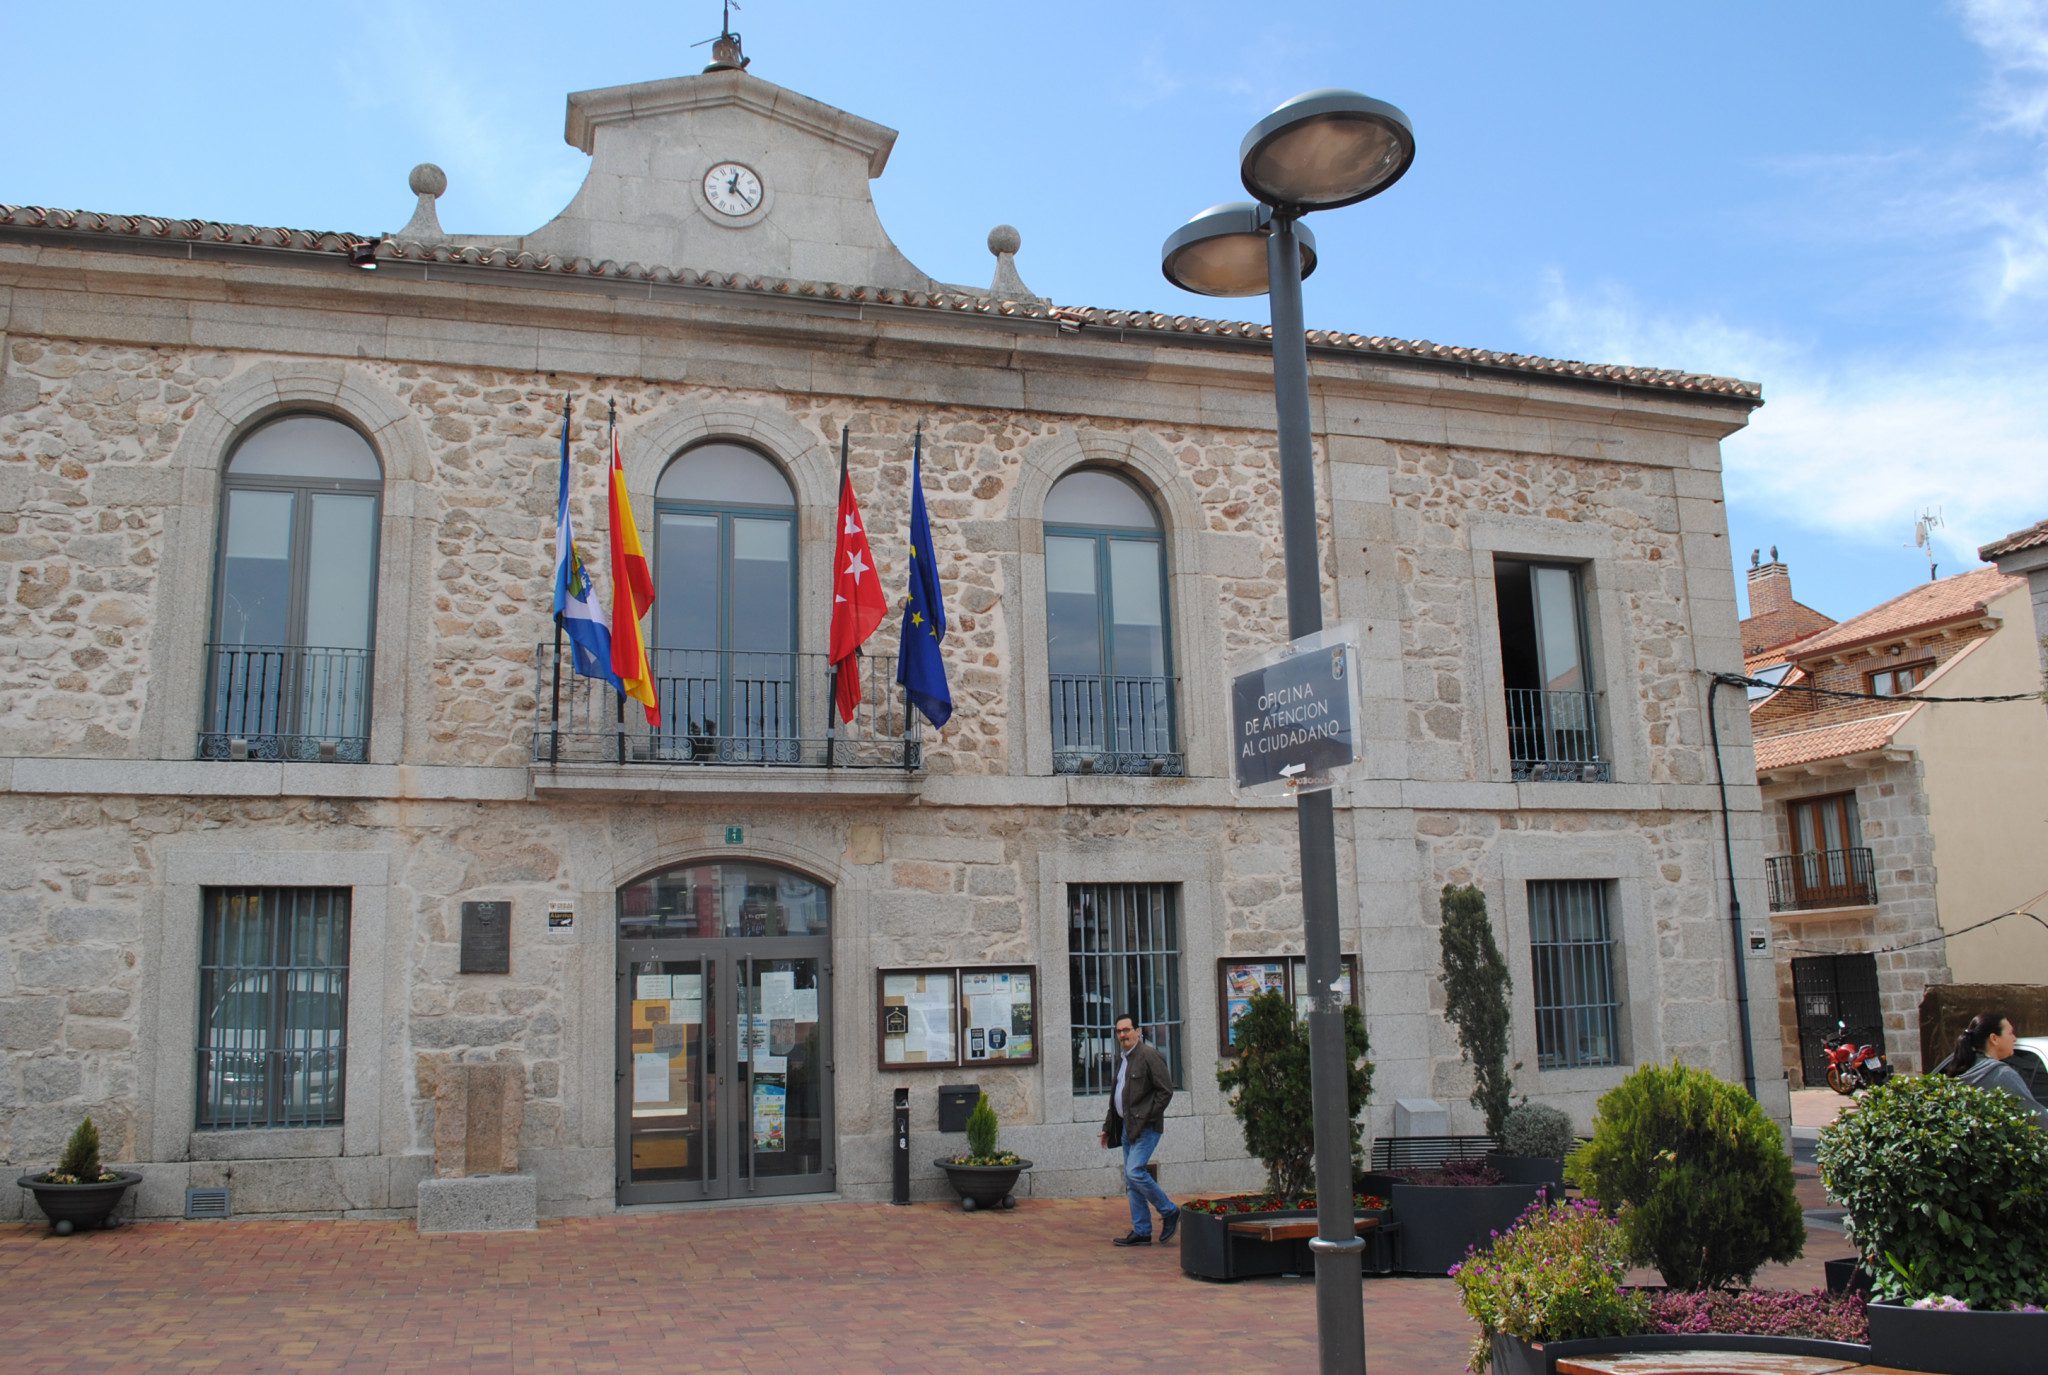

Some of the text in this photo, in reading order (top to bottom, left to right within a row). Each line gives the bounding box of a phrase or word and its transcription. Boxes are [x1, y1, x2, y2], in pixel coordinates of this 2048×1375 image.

[1258, 682, 1313, 711] OFICINA
[1245, 699, 1328, 736] DE ATENCION
[1242, 719, 1339, 758] AL CIUDADANO
